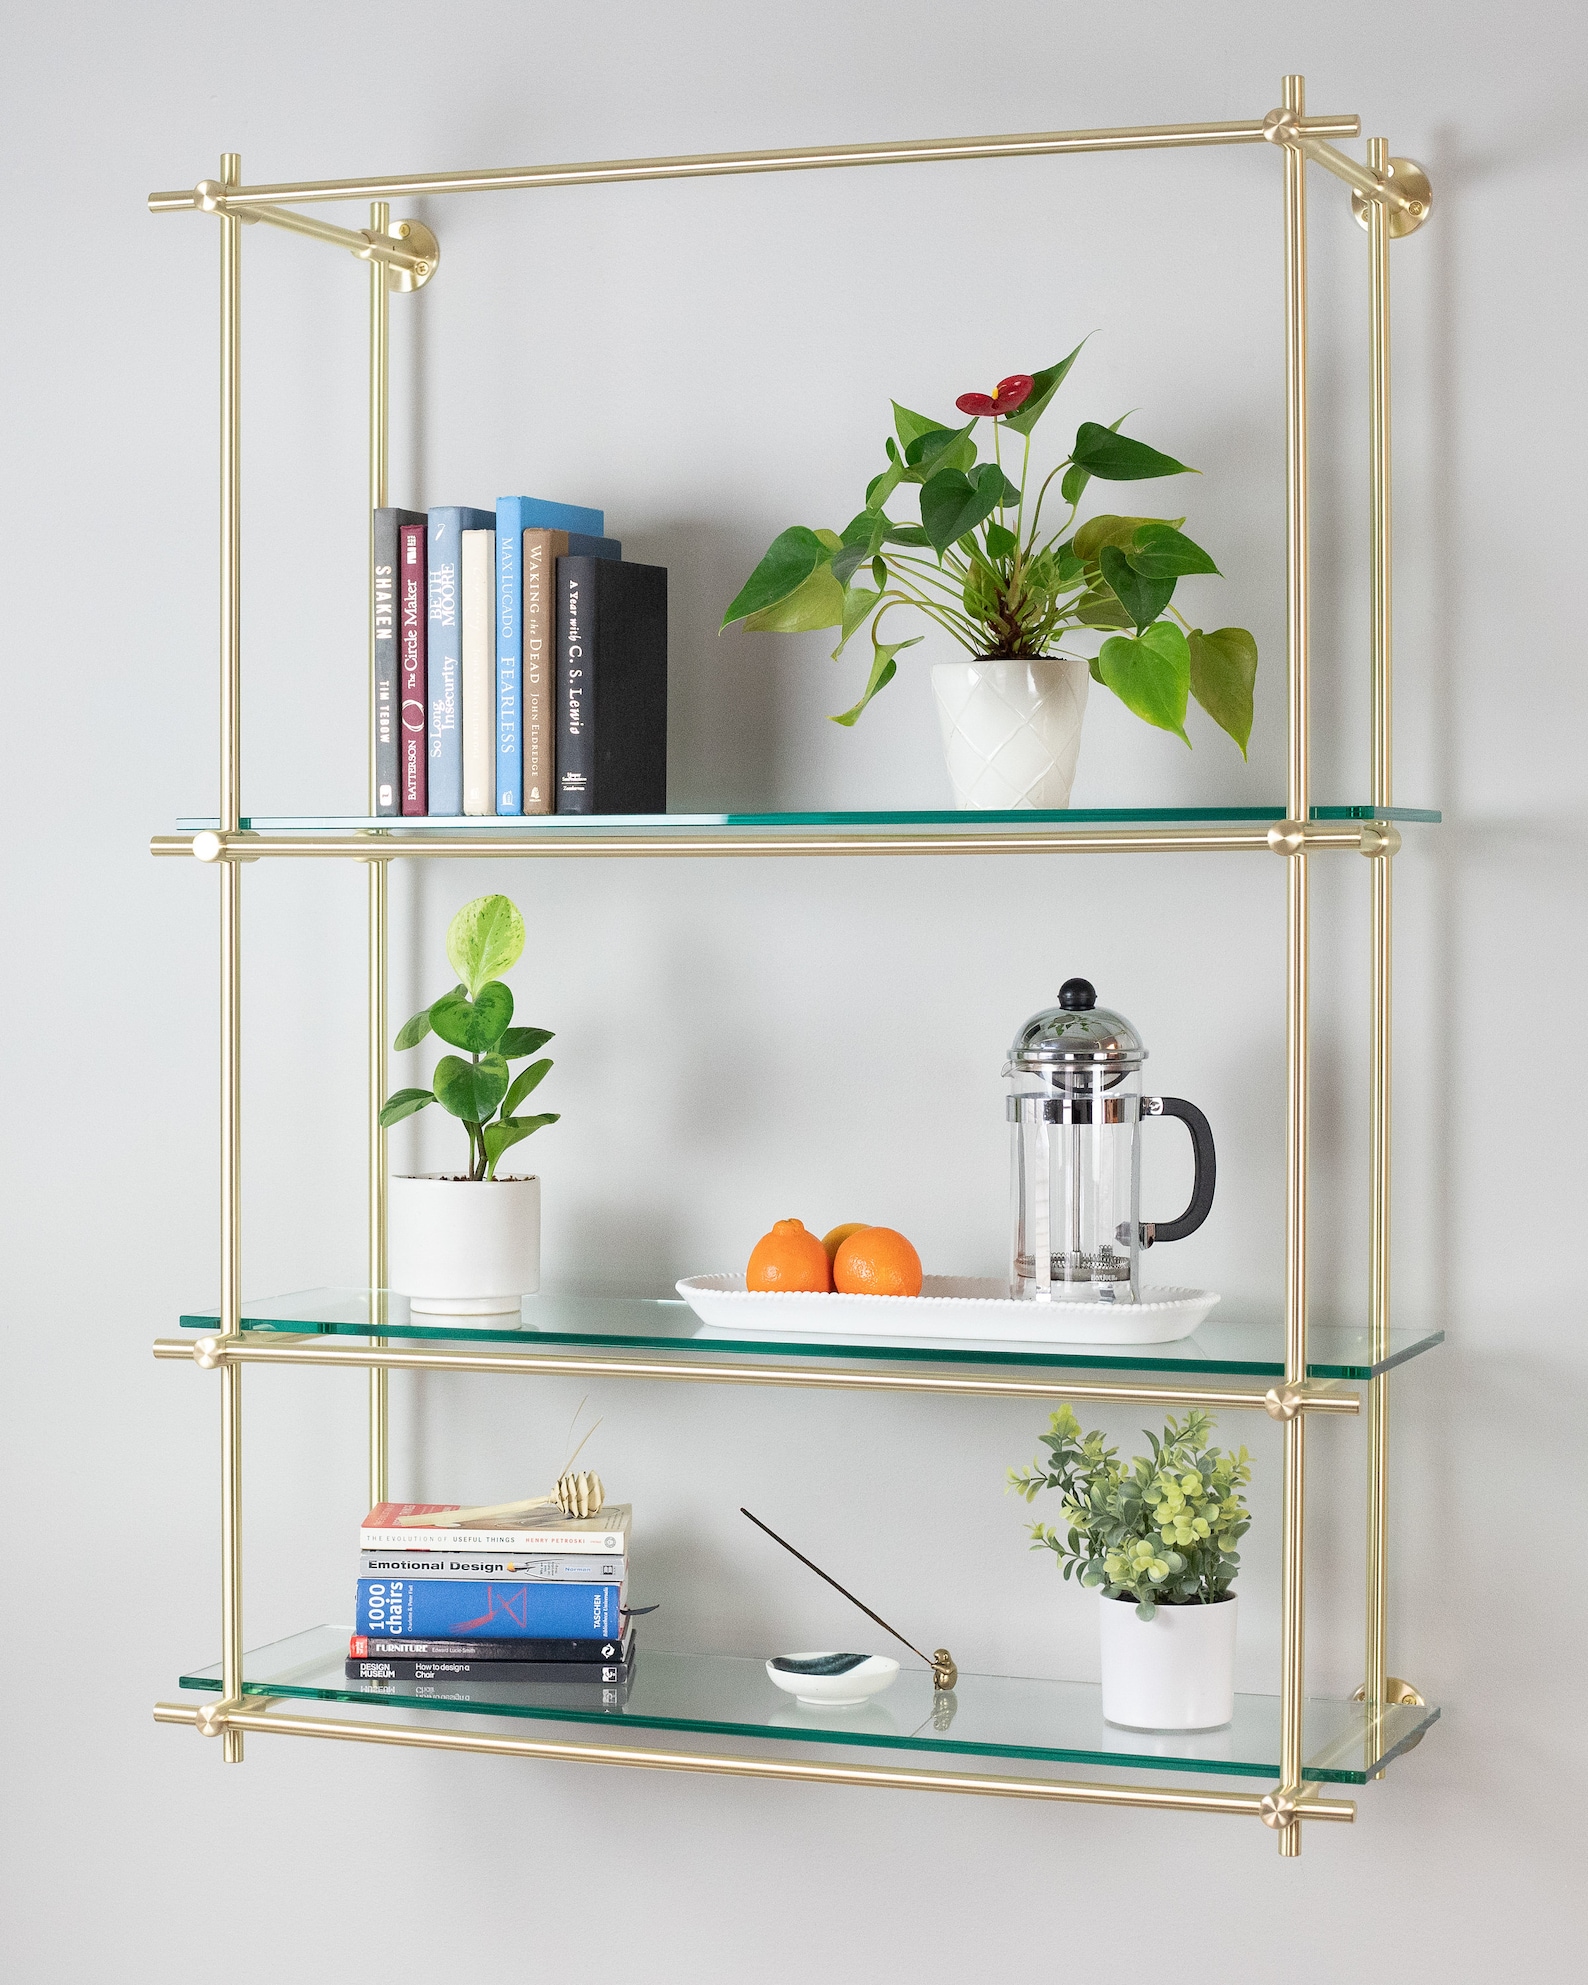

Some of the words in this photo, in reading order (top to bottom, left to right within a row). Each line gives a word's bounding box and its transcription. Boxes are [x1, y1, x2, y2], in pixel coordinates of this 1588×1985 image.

[502, 537, 513, 571] MAX
[430, 571, 440, 620] BETH
[442, 563, 455, 626] MOORE
[530, 545, 541, 613] WAKING
[570, 580, 578, 589] A
[376, 566, 391, 639] SHAKEN
[404, 580, 417, 625] Maker
[502, 575, 513, 638] LUCADO
[570, 591, 578, 615] Year
[530, 620, 538, 635] the
[568, 618, 581, 642] with
[404, 629, 417, 672] Circle
[529, 639, 541, 683] DEAD
[569, 645, 582, 663] C.
[380, 681, 389, 700] TIM
[442, 657, 458, 729] Insecurity
[569, 670, 582, 683] S.
[380, 705, 390, 743] TEBOW
[501, 656, 514, 753] FEARLESS
[569, 688, 584, 734] Lewis
[430, 740, 441, 757] So
[408, 740, 416, 800] BATTERSON
[368, 1560, 443, 1570] Emotional
[450, 1561, 503, 1573] Design
[368, 1584, 386, 1631] 1000
[386, 1582, 403, 1634] chairs
[360, 1663, 390, 1671] DESIGN
[376, 1644, 428, 1653] FURNITURE
[441, 1664, 464, 1672] design
